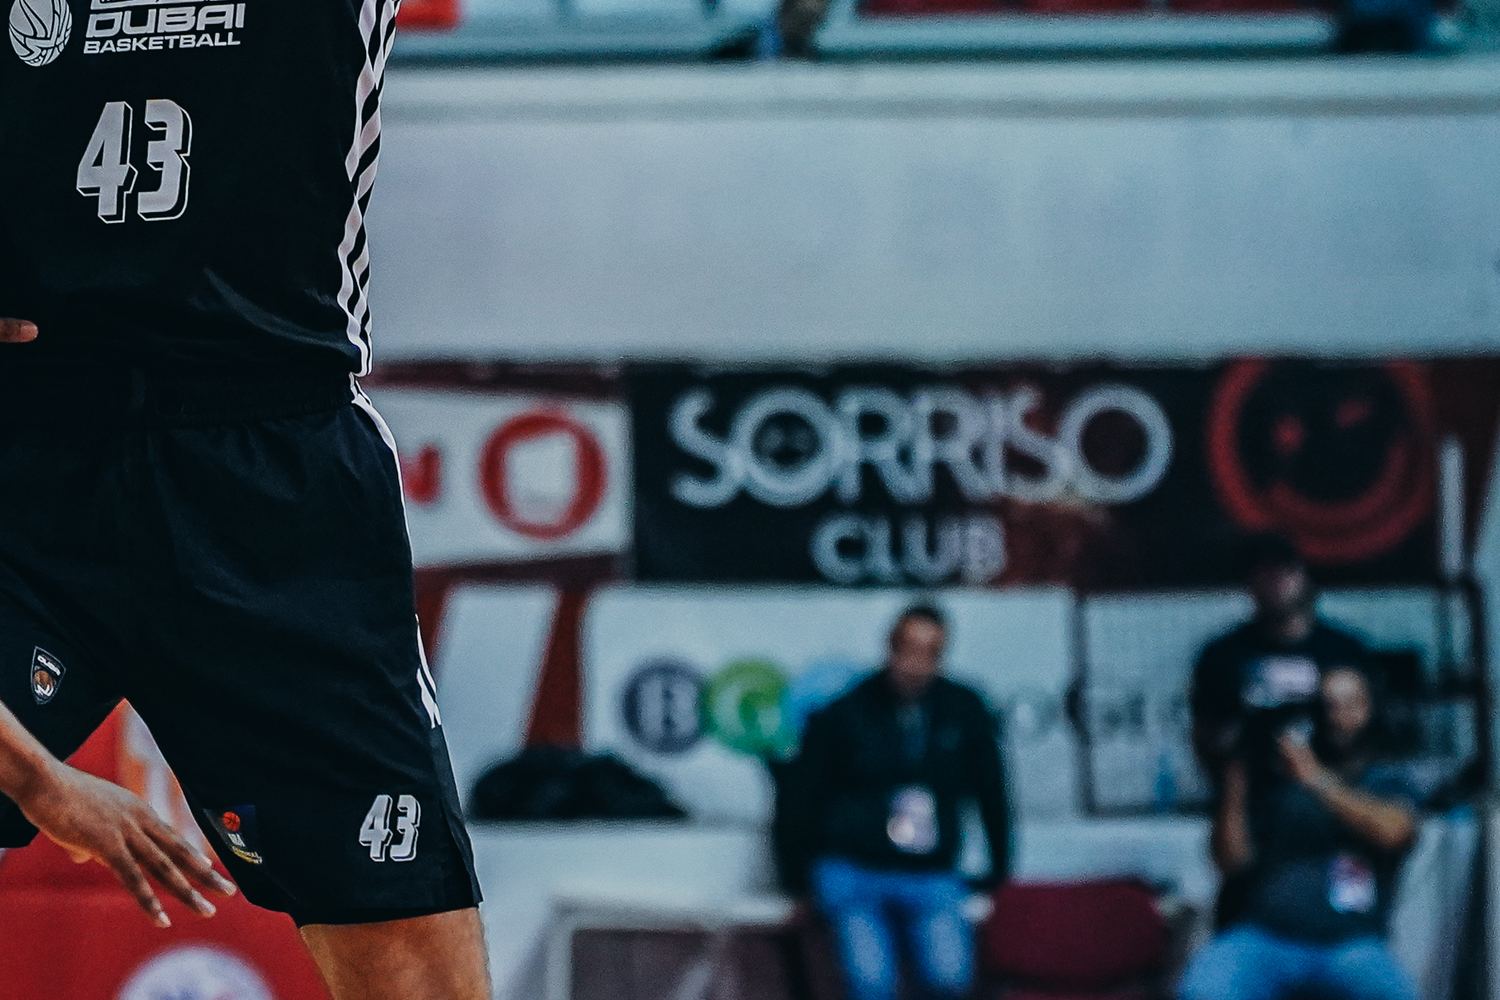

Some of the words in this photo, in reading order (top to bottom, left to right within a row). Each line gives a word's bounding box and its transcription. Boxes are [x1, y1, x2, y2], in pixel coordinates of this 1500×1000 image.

[83, 32, 241, 54] BASKETBALL
[85, 3, 246, 38] DUBAI
[76, 98, 192, 223] 43
[666, 384, 1174, 507] SORRISO
[809, 511, 1007, 586] CLUB
[359, 794, 421, 862] 43
